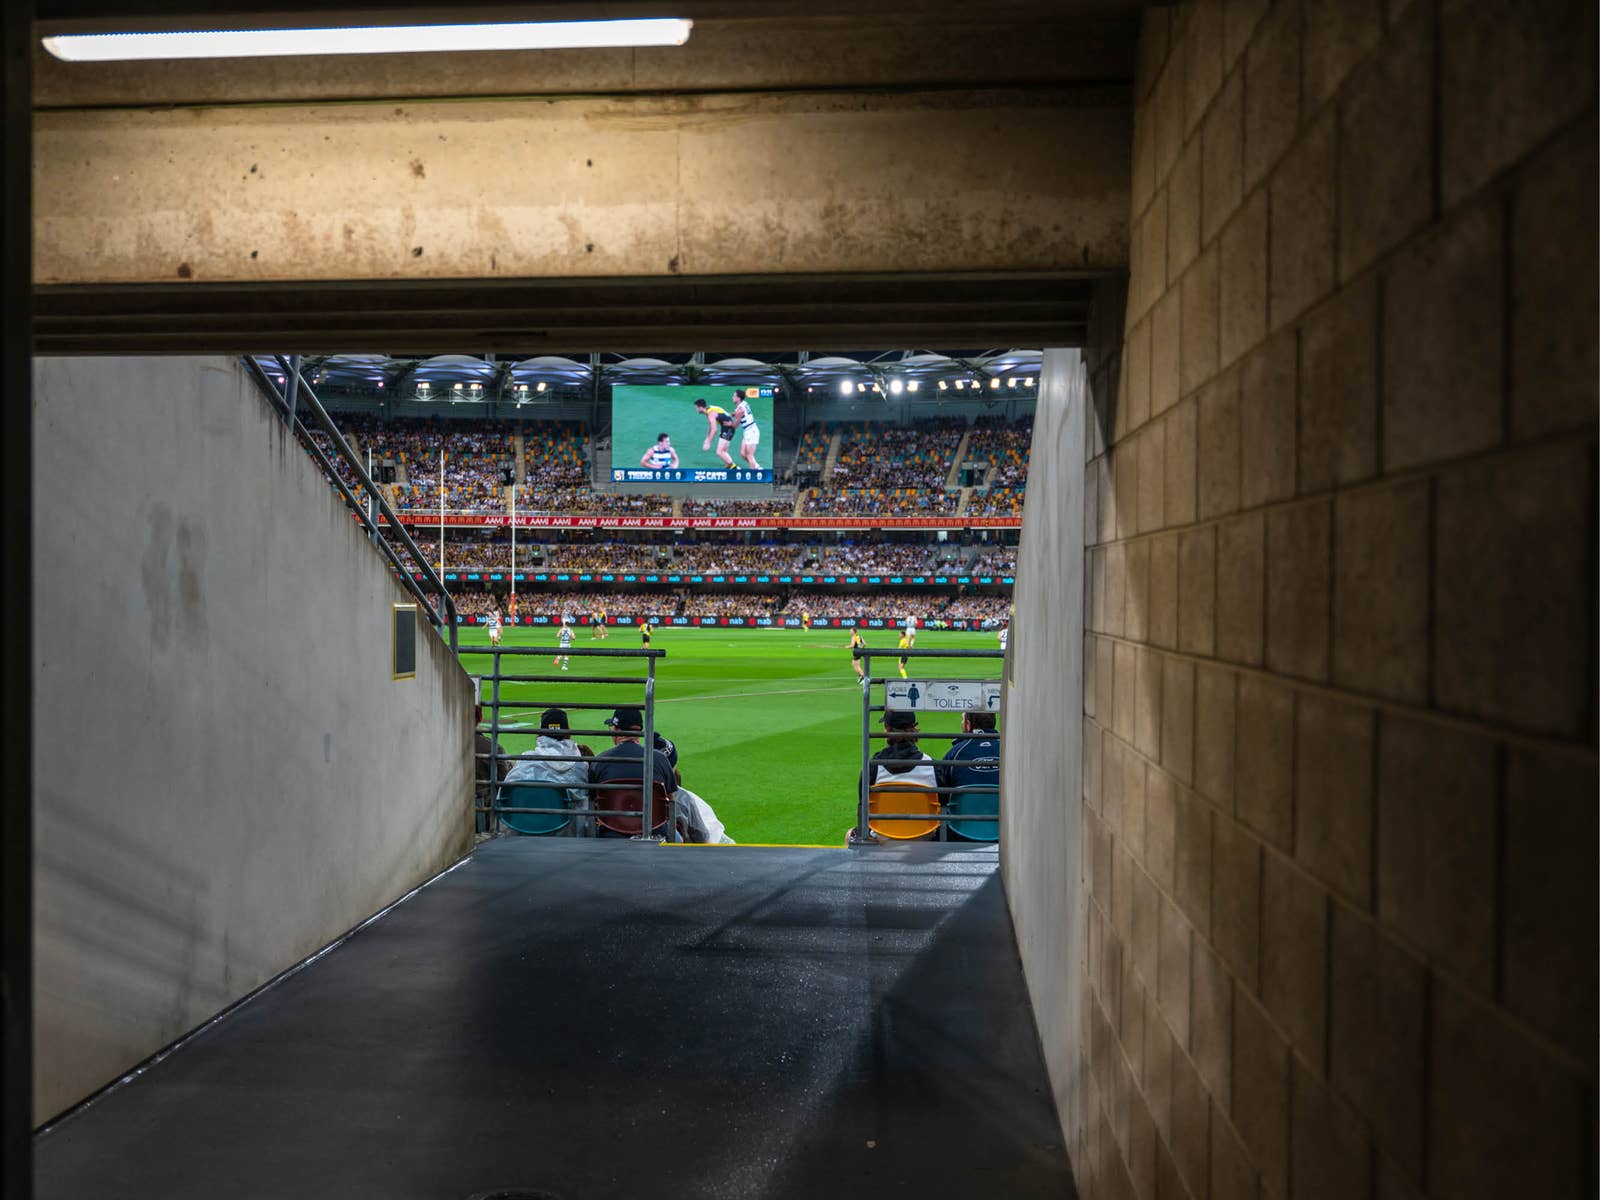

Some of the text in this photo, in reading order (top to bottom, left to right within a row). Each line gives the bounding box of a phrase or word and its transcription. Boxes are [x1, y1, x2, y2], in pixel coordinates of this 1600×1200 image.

[627, 470, 653, 480] TIGERS
[706, 471, 727, 480] CATS
[484, 516, 504, 525] AAMI
[529, 516, 549, 525] AAMI
[552, 517, 572, 525] AAMI
[578, 517, 598, 525] AAMI
[599, 517, 619, 526] AAMI
[621, 517, 642, 526] AAMI
[644, 518, 664, 526] AAMI
[670, 518, 690, 526] AAMI
[692, 518, 712, 526] AAMI
[715, 518, 734, 526] AAMI
[737, 518, 757, 527] AAMI
[445, 573, 458, 581] nab
[467, 573, 480, 581] nab
[535, 574, 548, 582] nab
[557, 574, 570, 582] nab
[579, 574, 592, 582] nab
[601, 574, 614, 582] nab
[690, 575, 703, 583] nab
[712, 575, 725, 583] nab
[735, 575, 748, 583] nab
[757, 575, 770, 583] nab
[779, 575, 792, 583] nab
[890, 576, 903, 584] nab
[912, 576, 925, 584] nab
[935, 576, 948, 584] nab
[957, 576, 970, 584] nab
[979, 576, 992, 584] nab
[1002, 576, 1015, 584] nab
[534, 616, 548, 624] nab
[617, 616, 632, 624] nab
[673, 616, 688, 624] nab
[701, 617, 716, 625] nab
[729, 617, 744, 625] nab
[757, 617, 772, 625] nab
[785, 618, 800, 626] nab
[813, 618, 828, 626] nab
[841, 619, 856, 627] nab
[868, 619, 883, 627] nab
[933, 698, 974, 709] TOILETS
